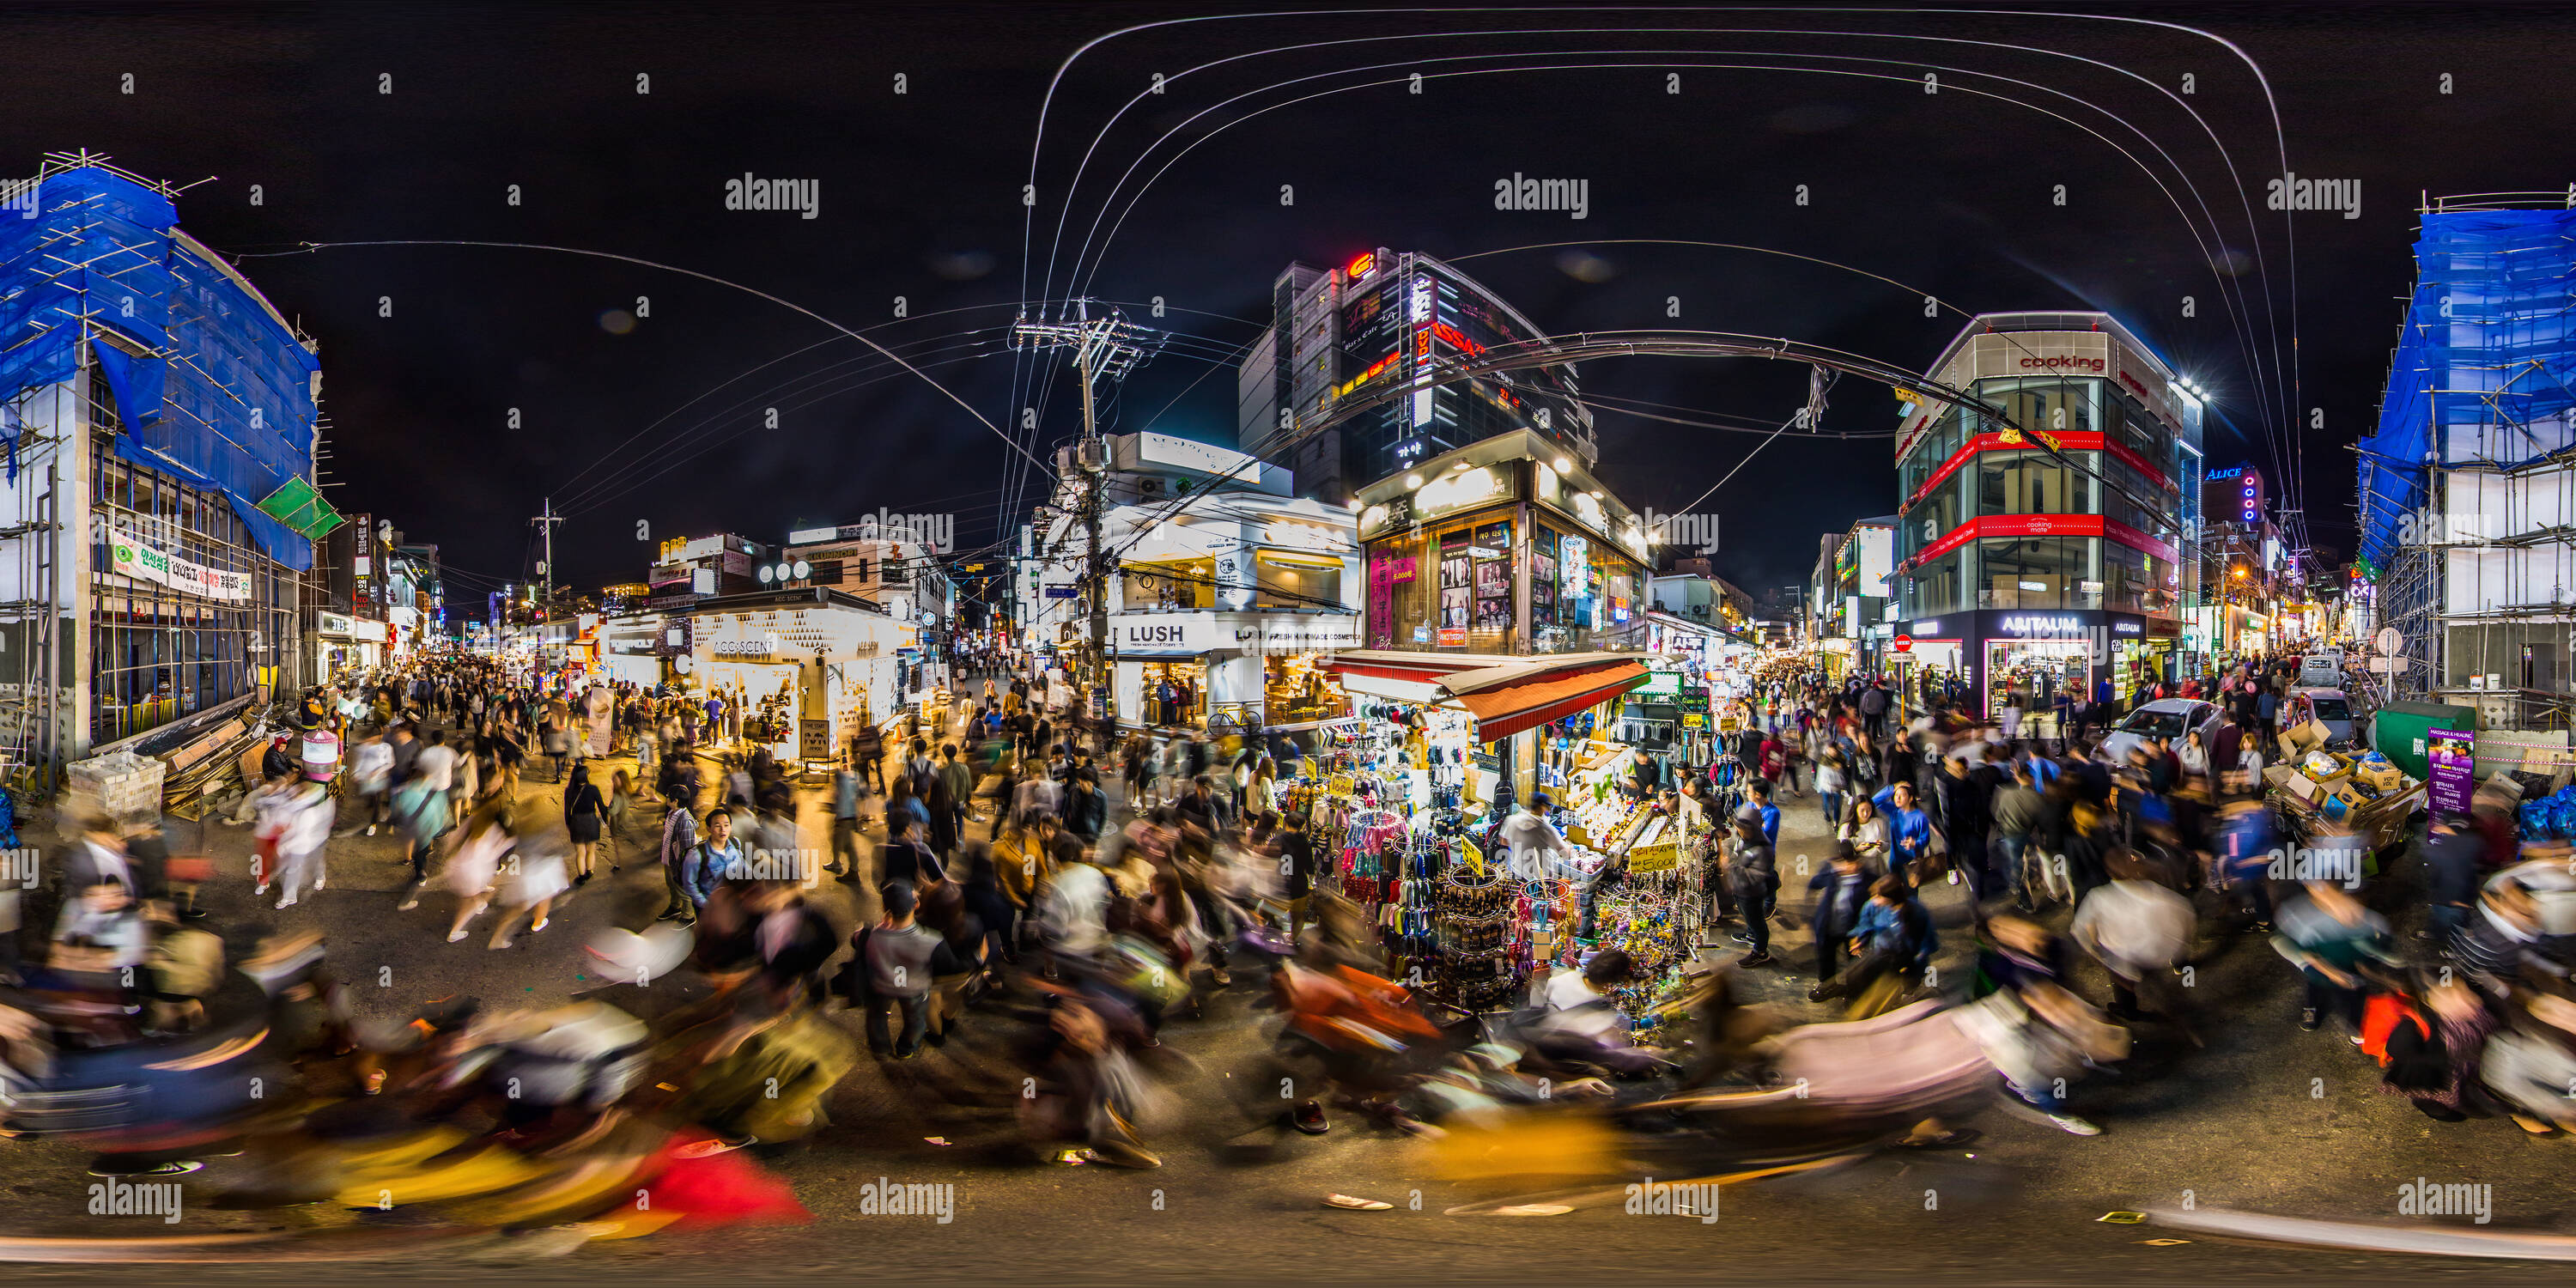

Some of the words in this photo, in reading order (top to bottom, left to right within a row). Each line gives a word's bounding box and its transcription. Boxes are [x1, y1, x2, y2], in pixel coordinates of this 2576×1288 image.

[1417, 330, 1430, 356] DVD
[1431, 323, 1476, 356] ASSA
[2020, 355, 2105, 372] cooking
[1397, 441, 1422, 458] 가야
[2204, 468, 2242, 481] ALICE
[2002, 617, 2078, 631] ARITAUM
[2115, 623, 2141, 633] ARITAUM
[1130, 625, 1183, 642] LUSH
[1236, 630, 1267, 641] LUSH
[1674, 637, 1703, 650] 사주
